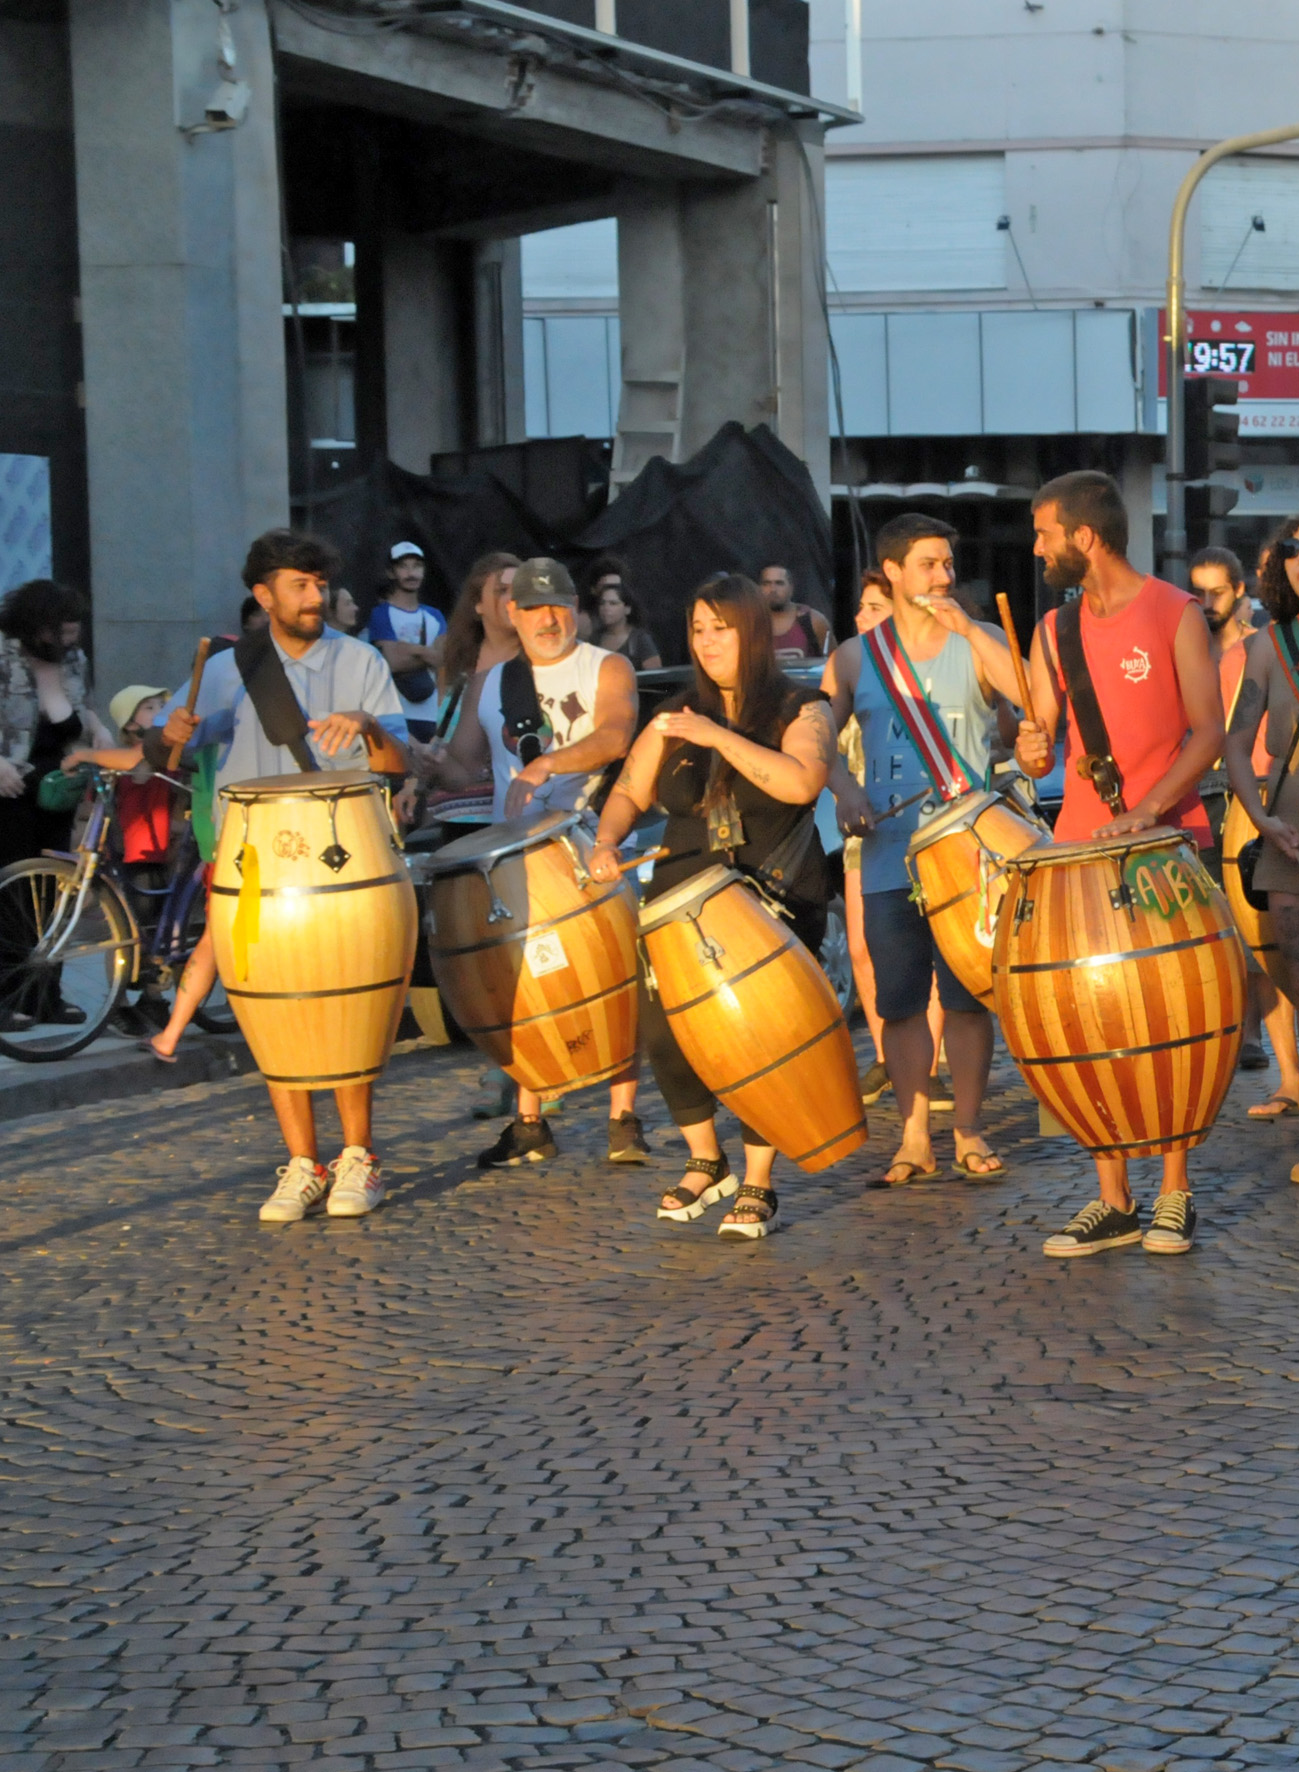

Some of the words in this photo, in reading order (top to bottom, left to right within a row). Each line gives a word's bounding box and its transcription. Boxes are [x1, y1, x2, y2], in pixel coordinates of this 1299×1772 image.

[1266, 331, 1288, 347] SIN
[1268, 352, 1282, 367] NI
[1286, 352, 1299, 367] EL
[1252, 416, 1266, 427] 62
[1271, 416, 1284, 427] 22
